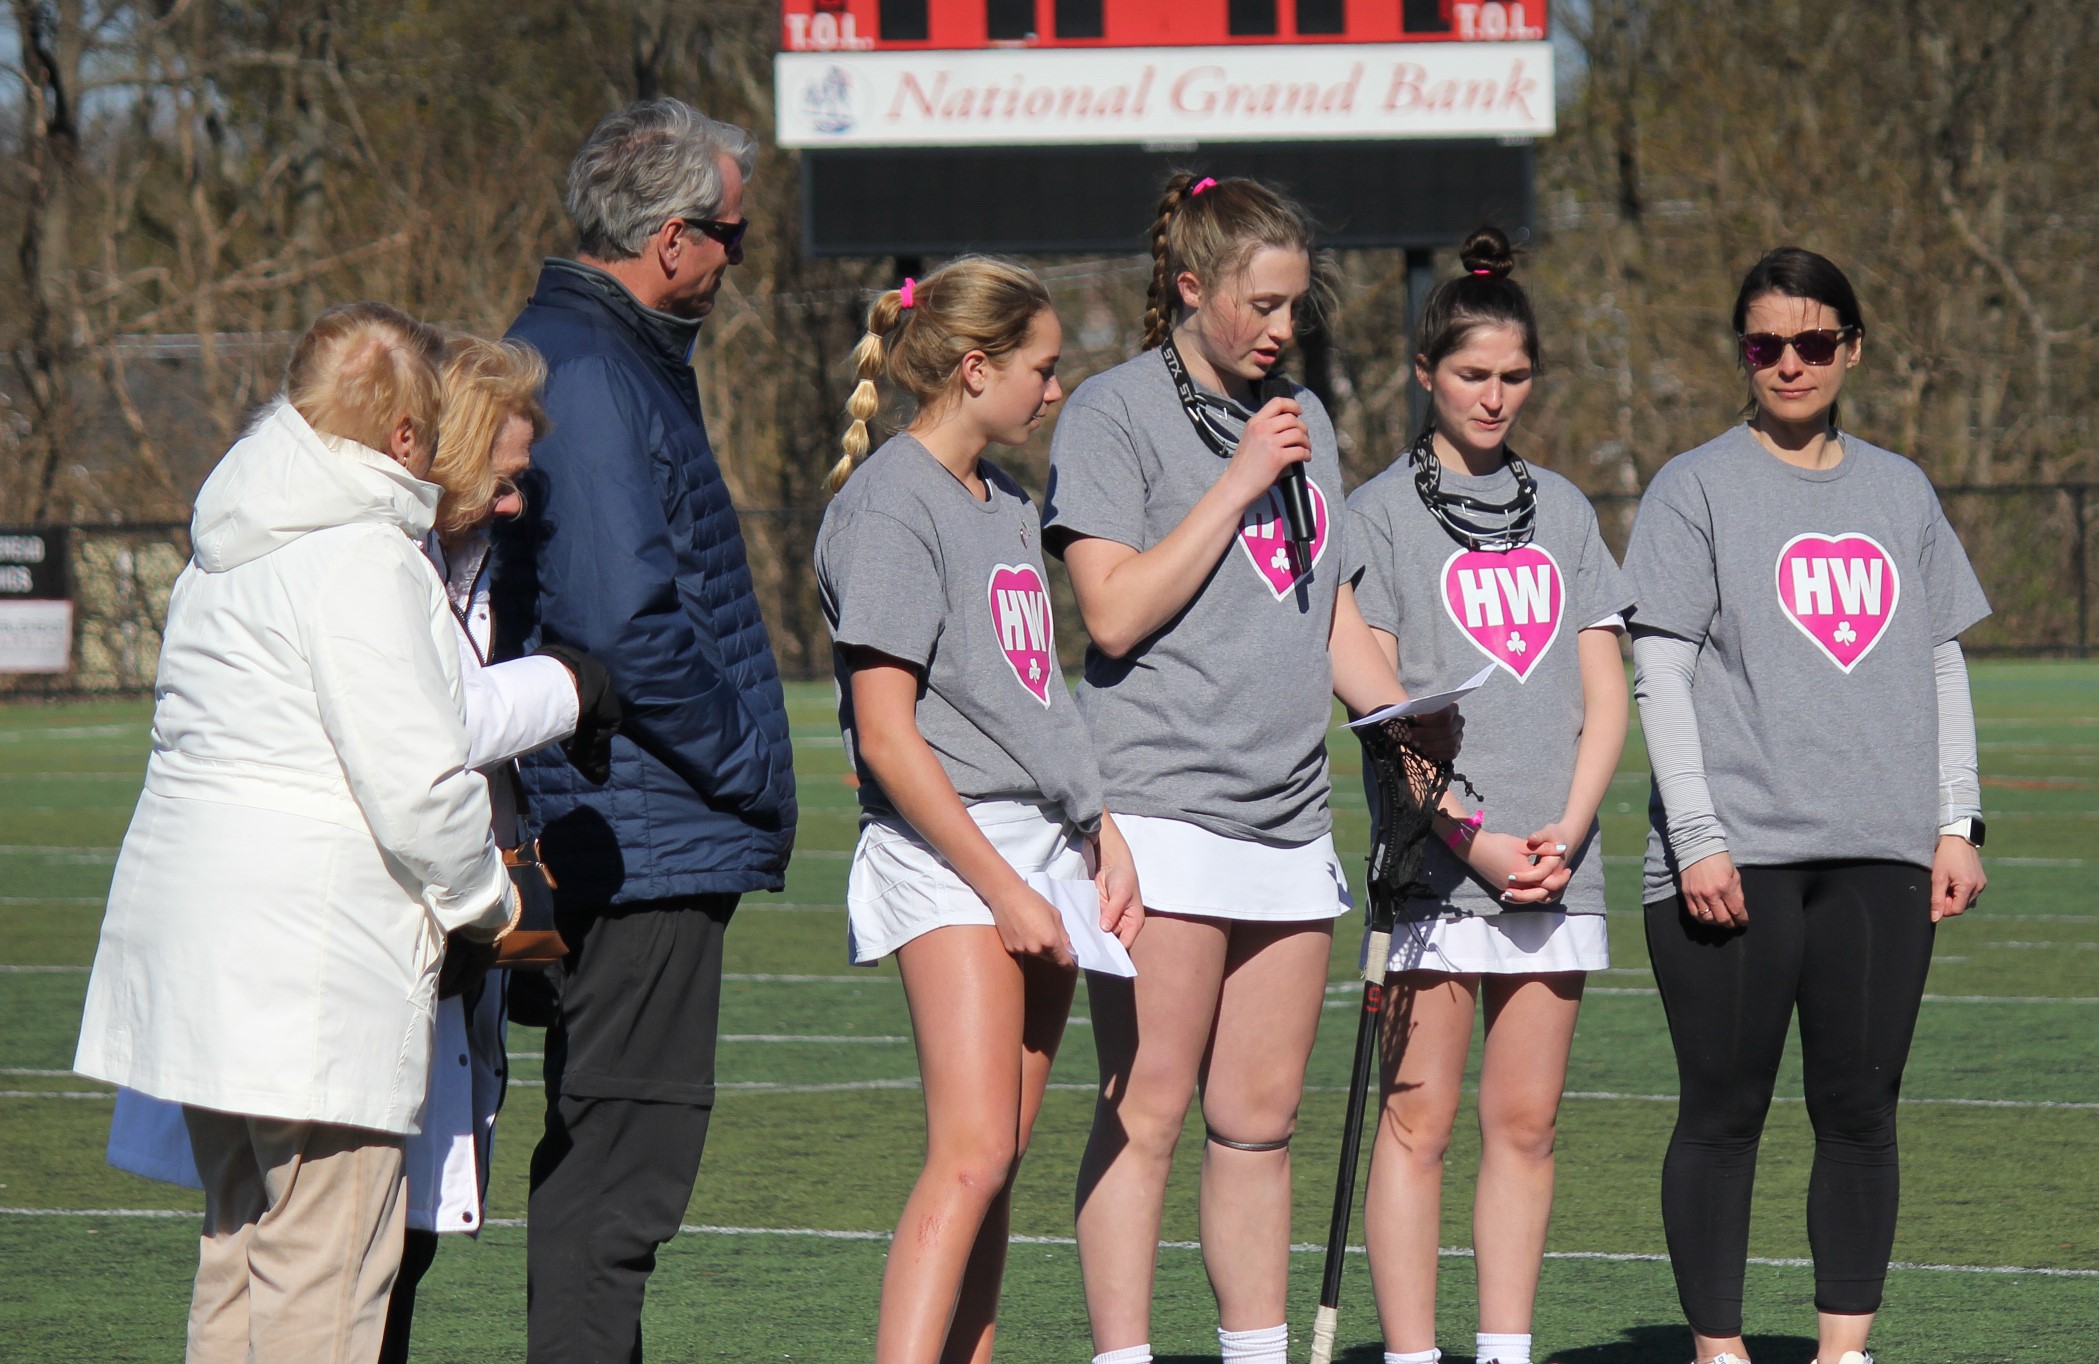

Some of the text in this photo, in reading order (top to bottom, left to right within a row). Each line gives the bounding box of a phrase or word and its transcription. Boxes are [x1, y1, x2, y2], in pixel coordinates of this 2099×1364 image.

[888, 56, 1538, 123] National Grand Bank
[1163, 347, 1183, 379] STX
[1457, 563, 1552, 628] HW
[1791, 557, 1883, 616] HW
[996, 588, 1047, 653] HW
